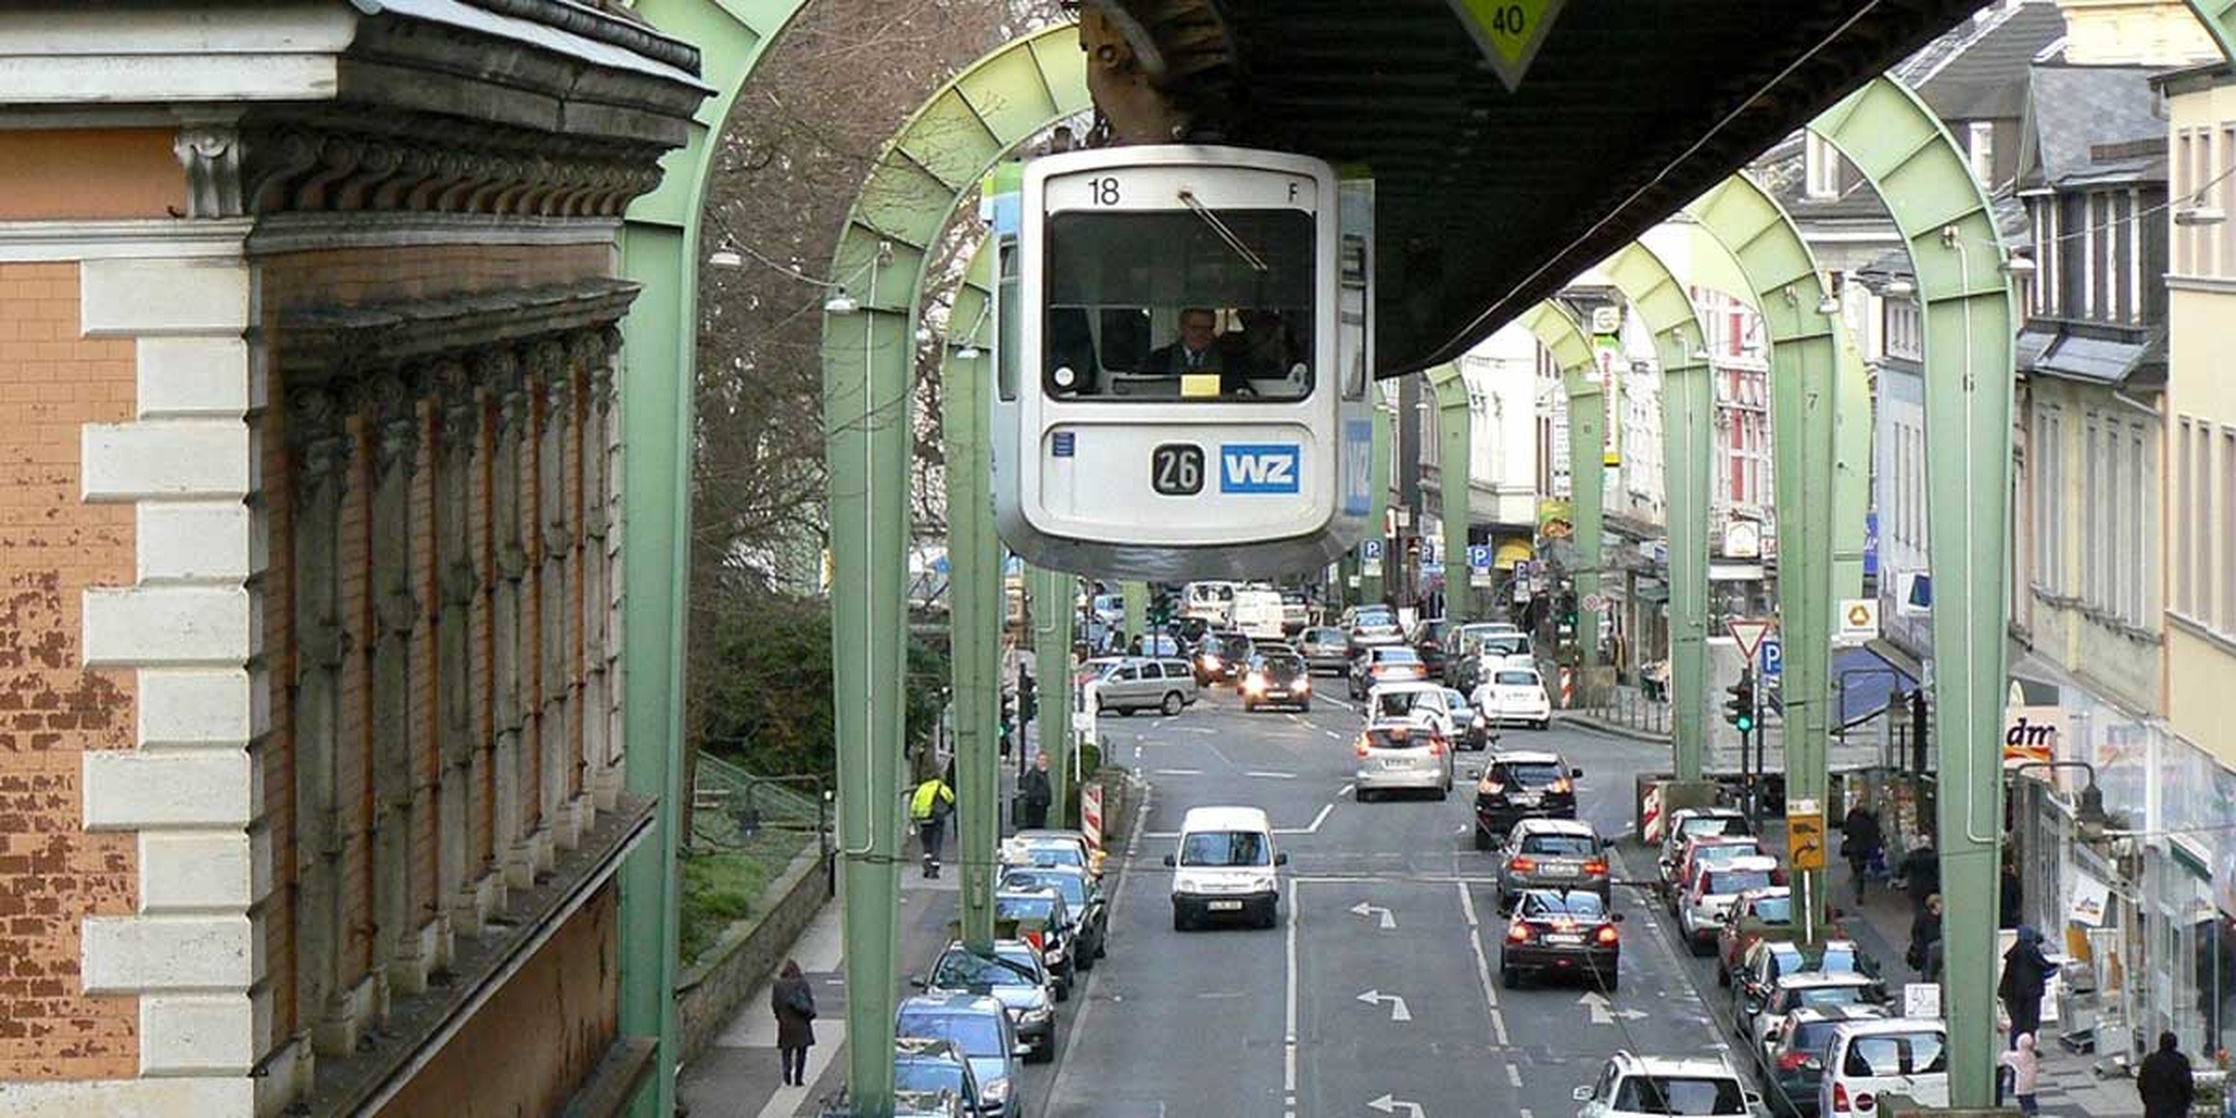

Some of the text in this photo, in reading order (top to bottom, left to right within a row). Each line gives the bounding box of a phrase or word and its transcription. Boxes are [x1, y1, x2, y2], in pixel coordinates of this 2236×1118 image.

[1492, 5, 1525, 36] 40
[1088, 177, 1120, 205] 18
[1289, 182, 1298, 203] F
[1807, 392, 1818, 410] 7
[1158, 450, 1198, 489] 26
[1225, 454, 1296, 484] WZ
[1367, 541, 1378, 557] P
[1475, 548, 1488, 565] P
[1766, 644, 1780, 671] P
[2006, 716, 2056, 746] dm
